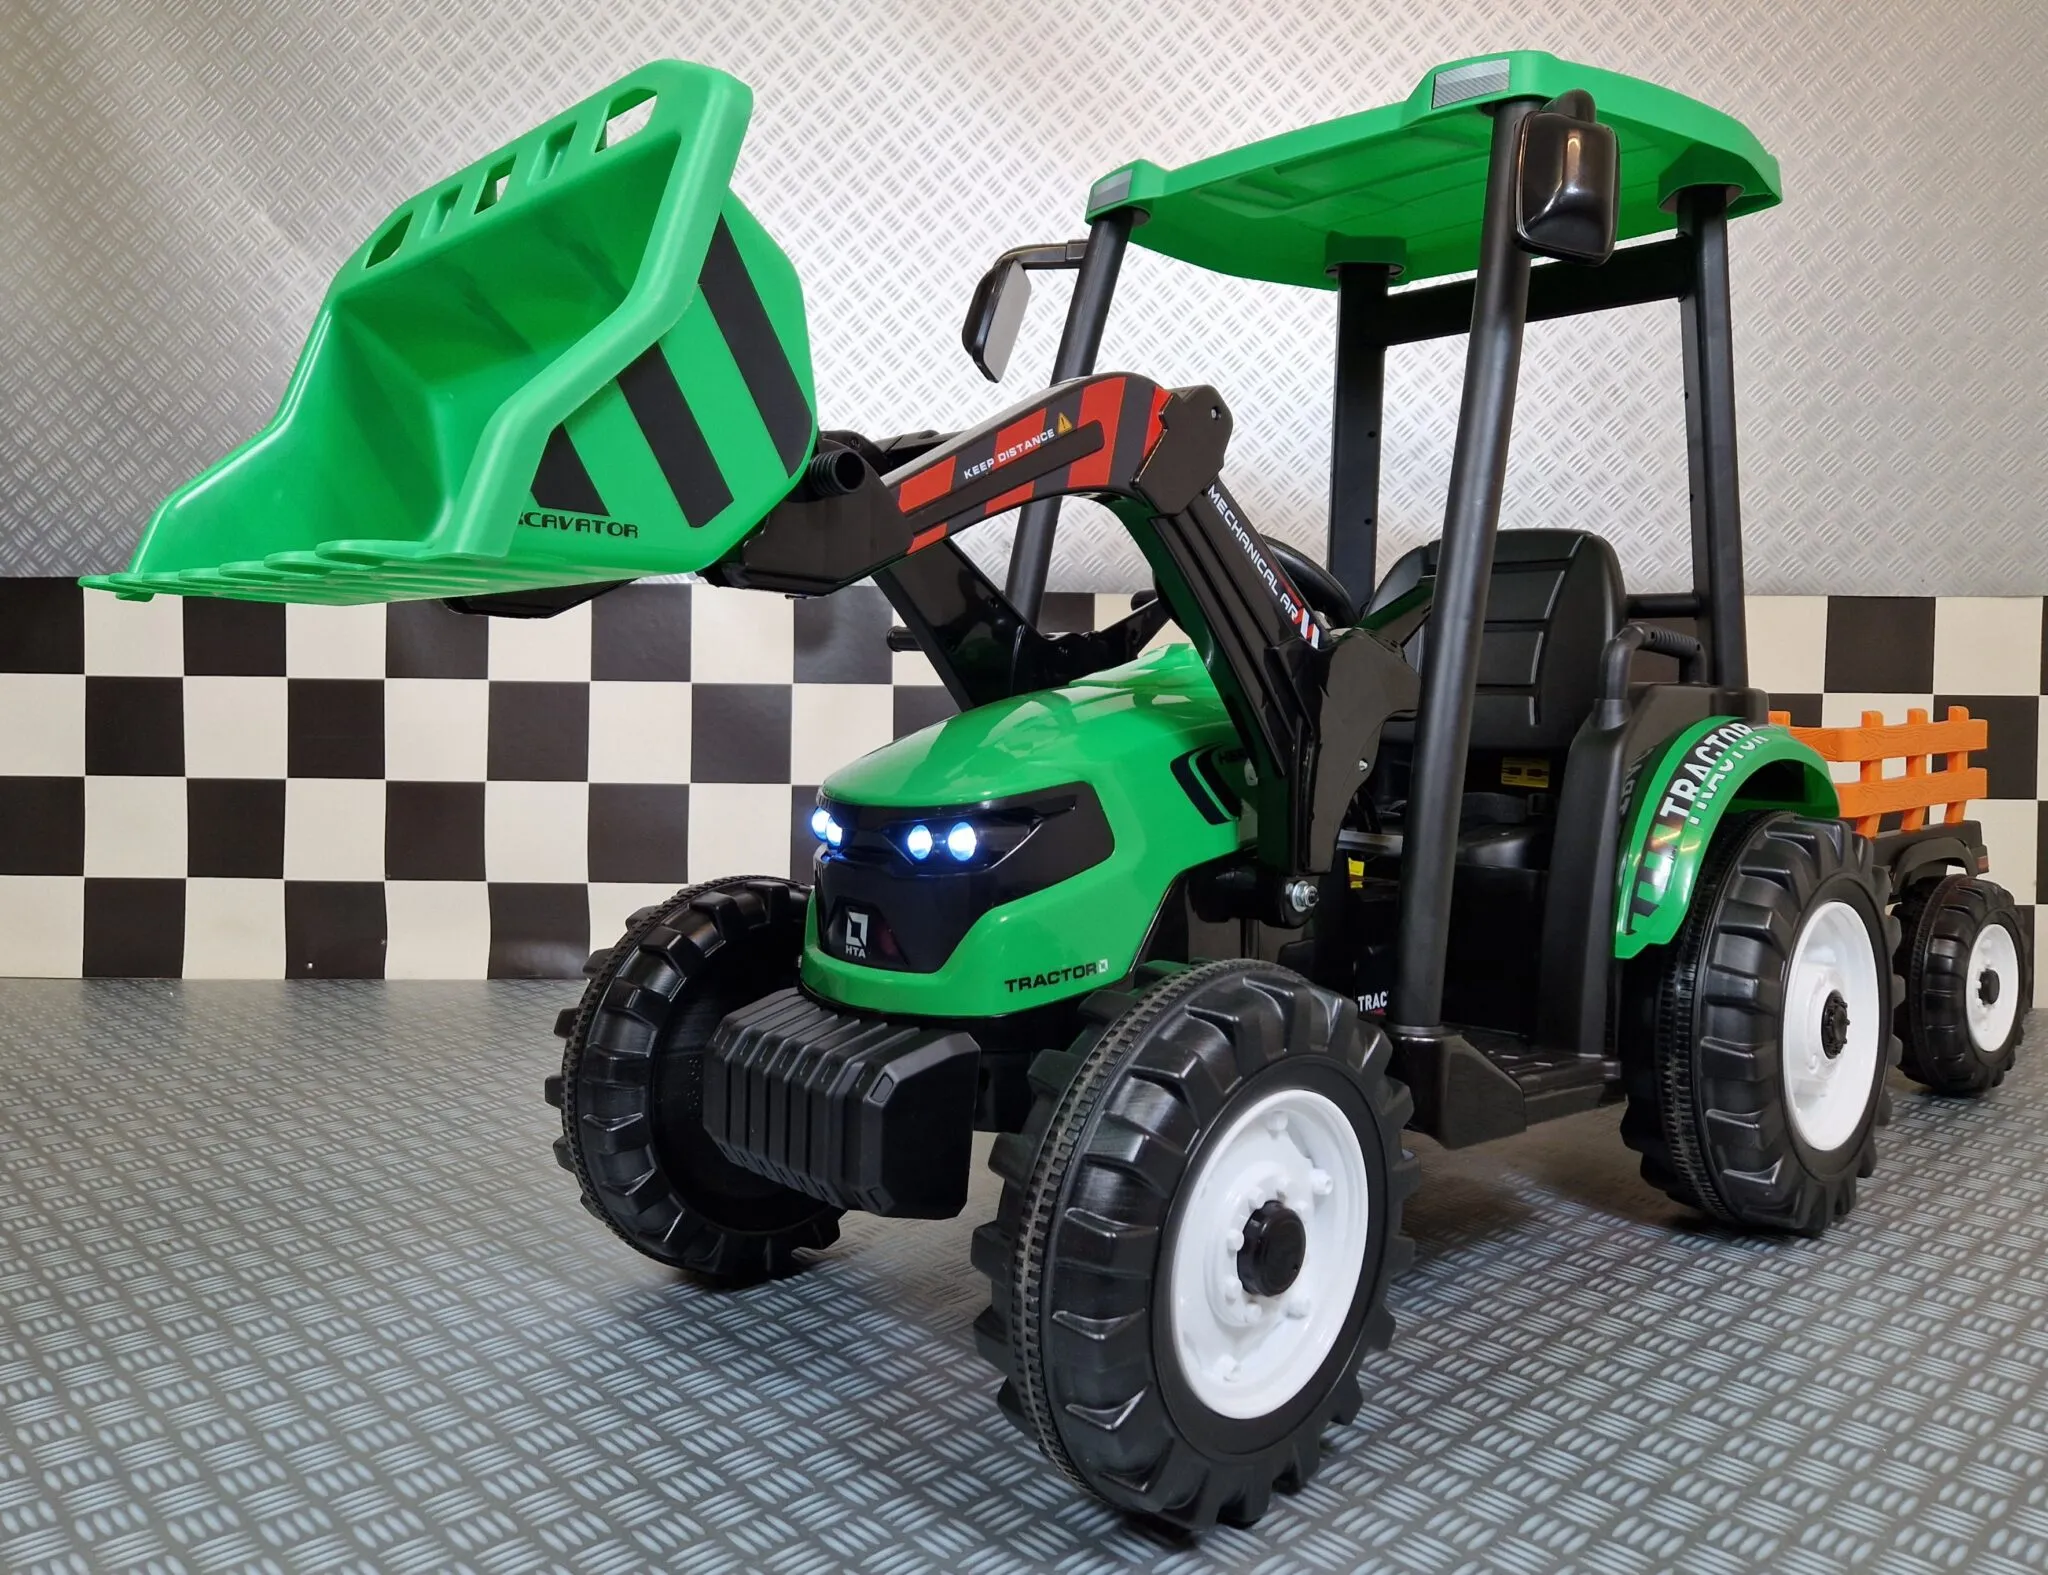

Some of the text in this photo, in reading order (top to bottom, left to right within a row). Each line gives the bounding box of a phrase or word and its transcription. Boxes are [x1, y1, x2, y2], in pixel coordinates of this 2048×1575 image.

[963, 428, 1055, 480] KEEP DISTANCE
[1207, 483, 1279, 597] MECHANICAL
[1659, 722, 1769, 826] TRACTOR
[845, 944, 867, 959] HTA
[1004, 962, 1098, 993] TRACTOR
[1357, 990, 1389, 1013] TRAC
